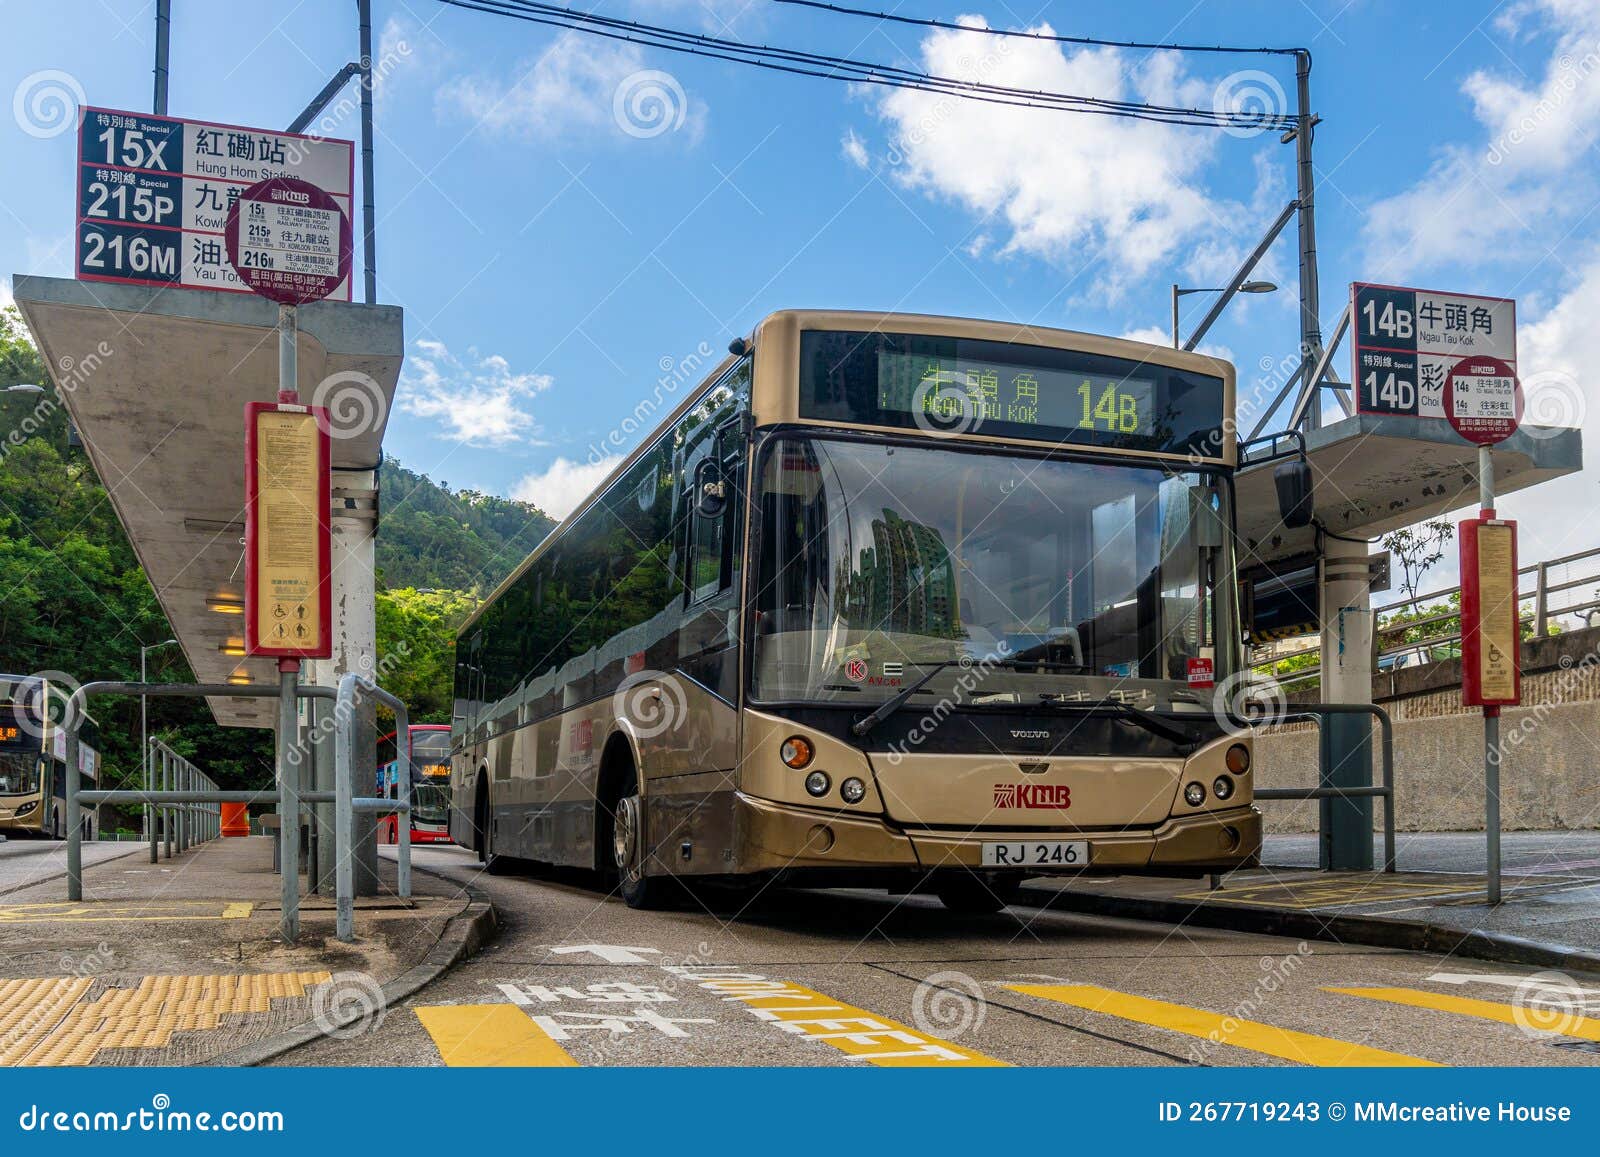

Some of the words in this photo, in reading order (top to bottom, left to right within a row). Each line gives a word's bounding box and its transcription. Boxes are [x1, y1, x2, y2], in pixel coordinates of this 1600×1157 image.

[97, 114, 137, 130] 特別線
[141, 124, 170, 134] Special
[99, 127, 168, 171] 15X
[196, 130, 286, 165] 紅磡站
[96, 169, 136, 185] 特別線
[140, 178, 169, 189] Special
[196, 160, 227, 177] Hung
[231, 165, 257, 179] Hom
[87, 183, 174, 223] 215P
[281, 190, 310, 203] KMB
[248, 224, 271, 238] 215P
[83, 232, 175, 275] 216M
[193, 238, 230, 266] 油
[244, 251, 274, 269] 216M
[193, 266, 216, 280] Yau
[1363, 300, 1413, 339] 14B
[1419, 301, 1492, 335] 牛頭角
[1420, 331, 1440, 344] Ngau
[1443, 333, 1458, 344] Tau
[1460, 335, 1474, 345] Kok
[1364, 355, 1392, 367] 特別線
[922, 363, 1039, 405] 牛頭角
[1365, 371, 1415, 410] 14D
[922, 394, 964, 417] NGAU
[971, 399, 1000, 420] TAU
[1008, 405, 1038, 424] KOK
[1077, 380, 1138, 433] 14B
[1421, 395, 1440, 407] Choi
[1010, 730, 1050, 738] VOLVO
[1016, 784, 1072, 809] KMB
[995, 845, 1025, 864] RJ
[1036, 844, 1077, 864] 246
[744, 1006, 972, 1061] LEFT
